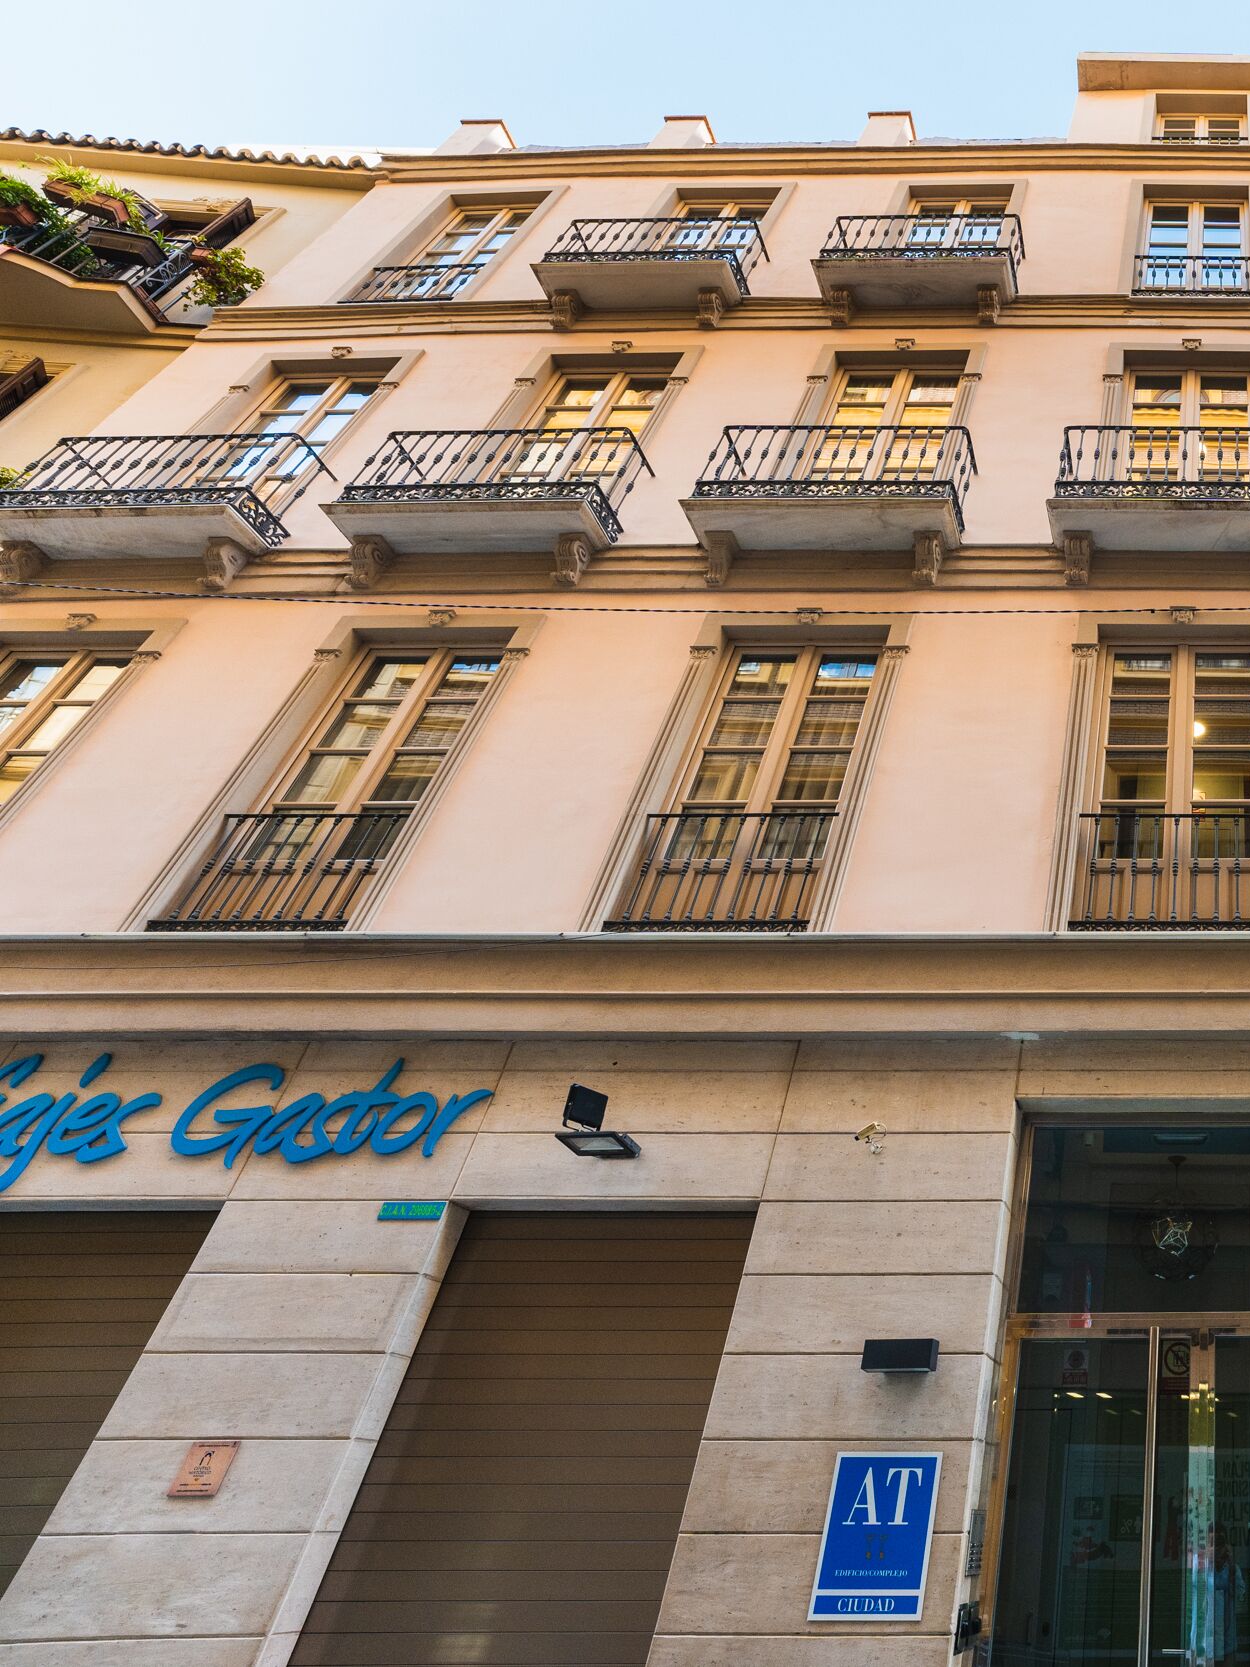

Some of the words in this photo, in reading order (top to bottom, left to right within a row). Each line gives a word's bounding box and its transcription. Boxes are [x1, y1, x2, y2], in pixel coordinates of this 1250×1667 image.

[0, 1052, 162, 1192] ajes
[170, 1057, 495, 1169] Gastor
[842, 1466, 924, 1526] AT
[837, 1598, 895, 1612] CIUDAD
